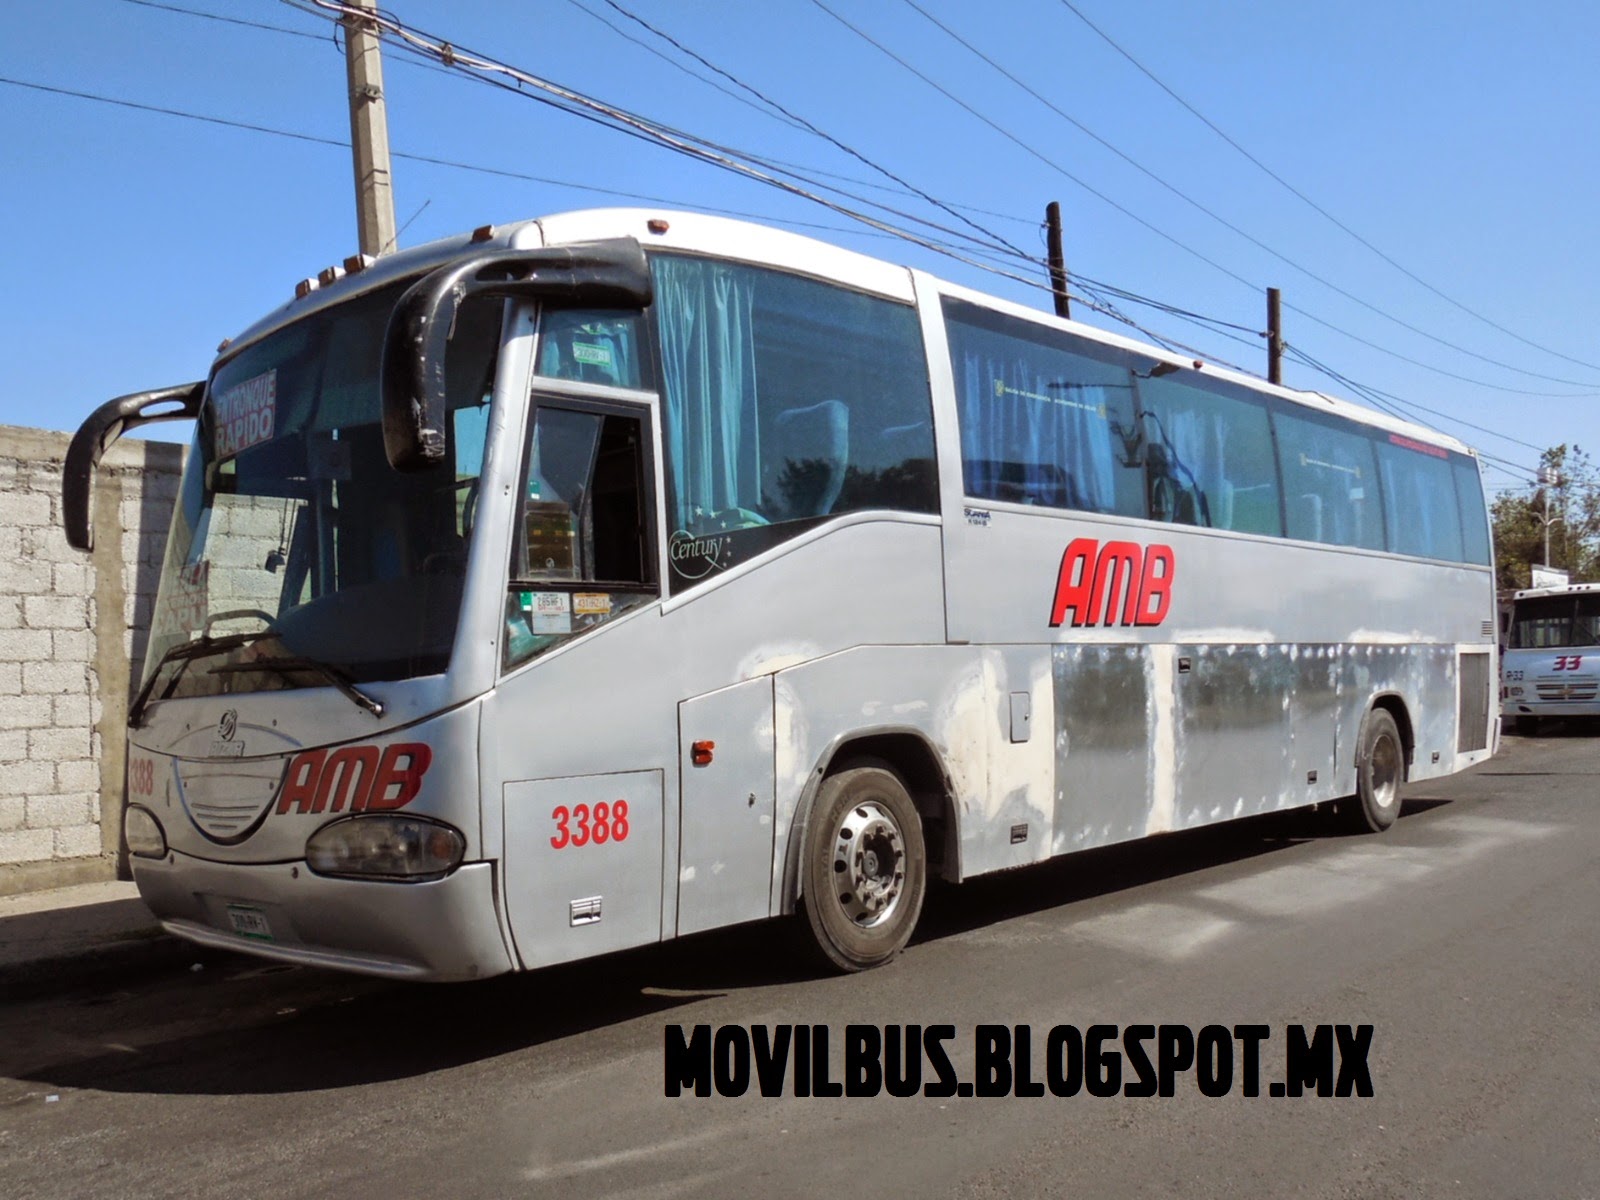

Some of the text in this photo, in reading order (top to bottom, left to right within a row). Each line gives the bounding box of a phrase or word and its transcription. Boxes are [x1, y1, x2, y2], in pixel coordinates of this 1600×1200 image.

[215, 406, 274, 457] RAPIDO
[670, 537, 723, 561] Century
[1049, 537, 1176, 628] AMB
[1552, 655, 1583, 672] 33
[275, 742, 432, 815] AMB
[549, 799, 629, 850] 3388
